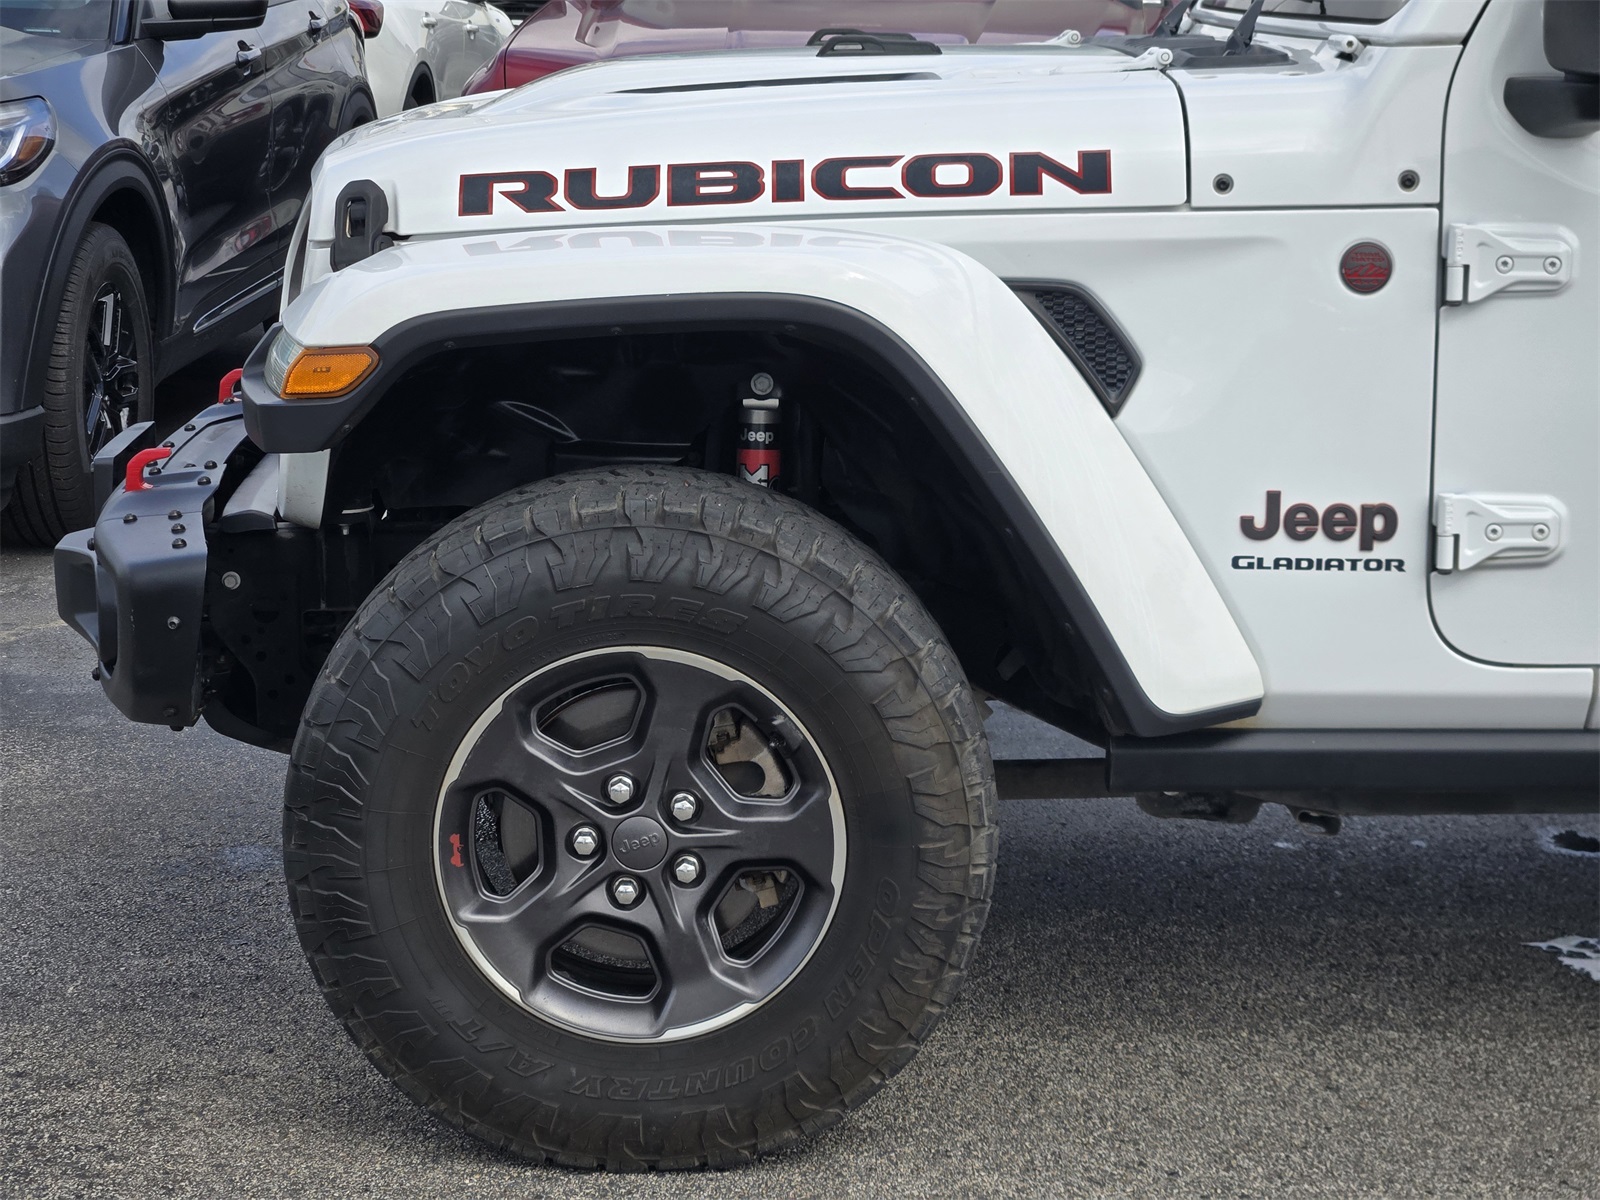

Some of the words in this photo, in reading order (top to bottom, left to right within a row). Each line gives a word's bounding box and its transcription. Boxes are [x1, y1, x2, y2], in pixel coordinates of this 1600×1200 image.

[459, 149, 1111, 216] RUBICON
[741, 428, 774, 445] Jeep
[1240, 490, 1398, 551] Jeep
[1231, 555, 1406, 572] GLADIATOR
[410, 616, 539, 731] TOYO
[550, 594, 749, 634] TIRES
[619, 832, 661, 853] Jeep
[822, 877, 900, 1020] OPEN
[563, 1015, 819, 1101] COUNTRY
